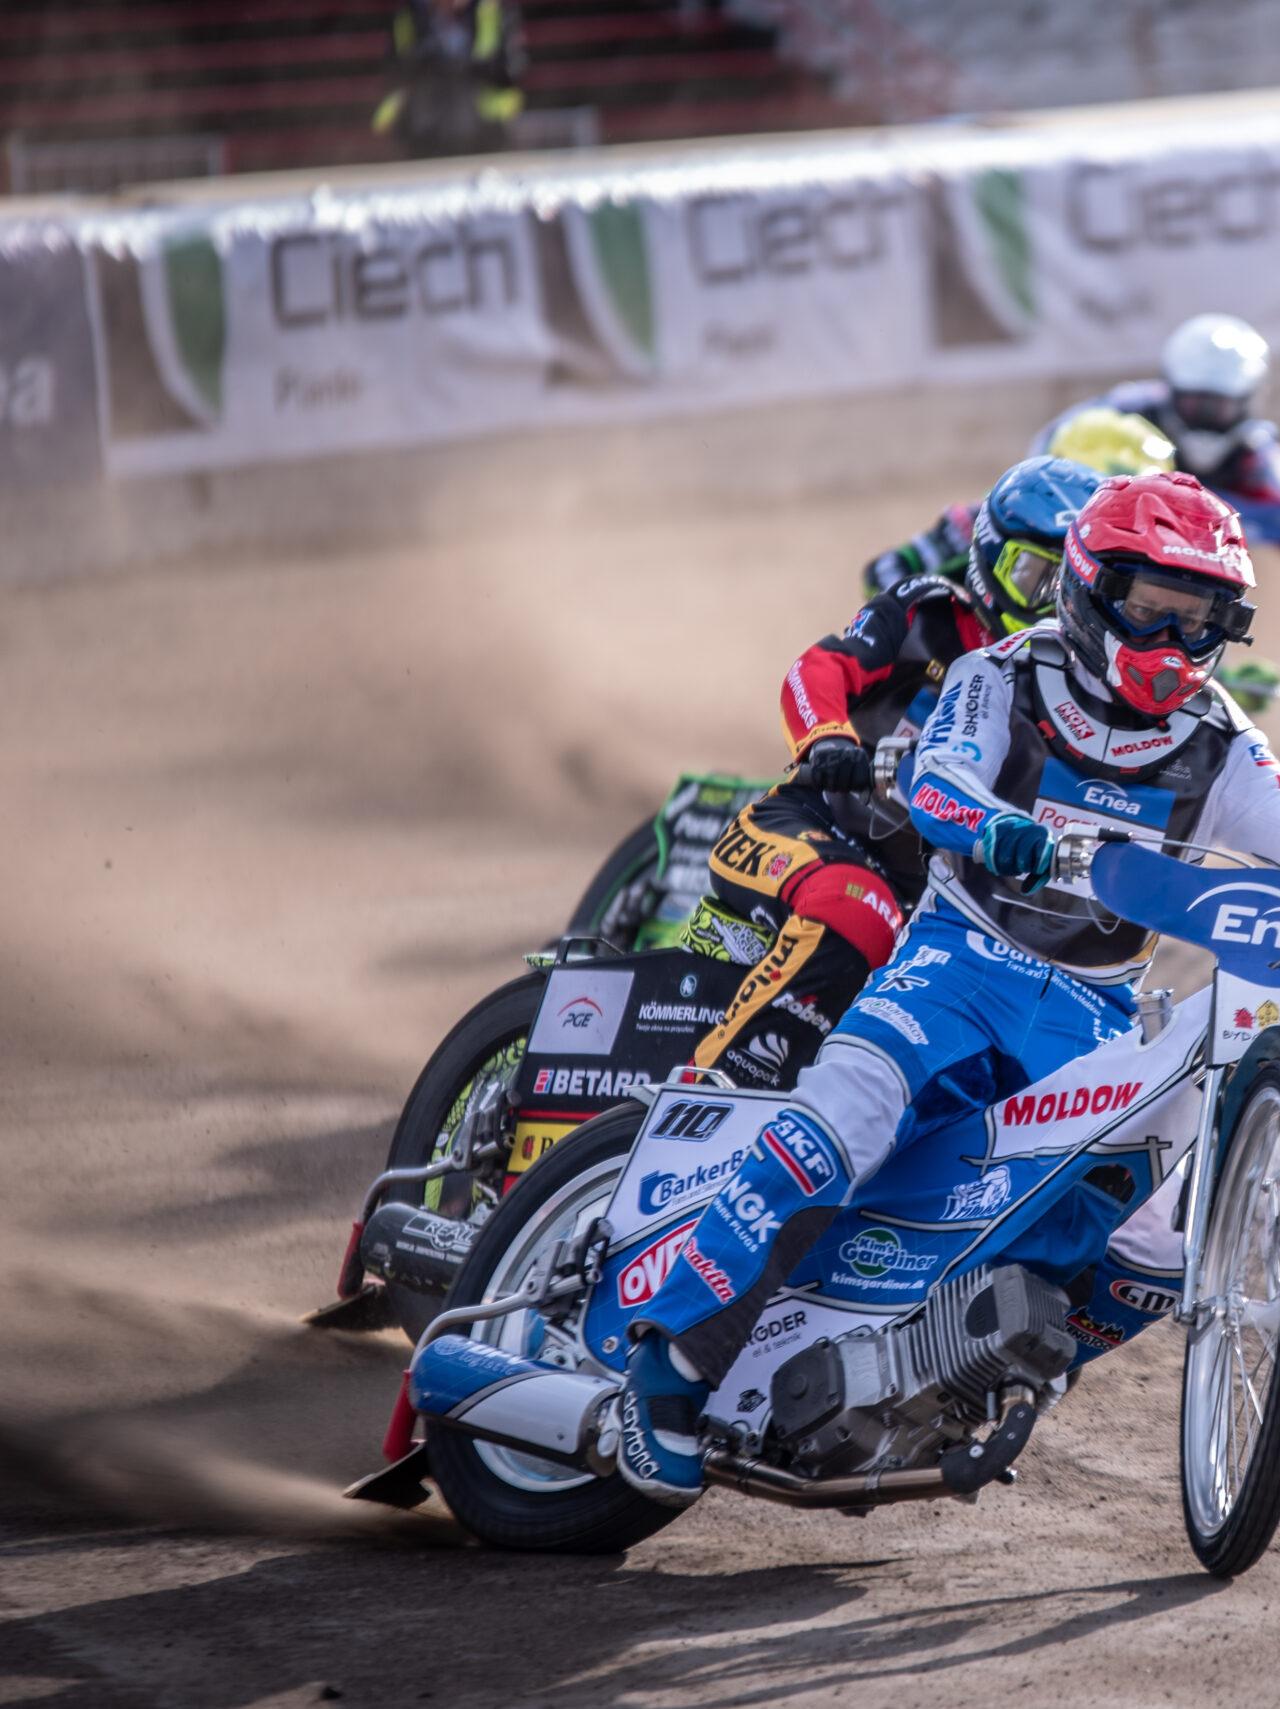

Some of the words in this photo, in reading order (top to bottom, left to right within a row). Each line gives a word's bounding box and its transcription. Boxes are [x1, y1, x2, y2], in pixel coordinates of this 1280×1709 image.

[271, 222, 518, 329] Ciech
[1110, 735, 1174, 758] MOLDOW
[912, 782, 987, 833] MOLDOW
[1083, 786, 1142, 816] Enea
[562, 1012, 593, 1028] PGE
[638, 1000, 726, 1025] KÖMMERLING
[651, 1101, 734, 1141] 110
[1004, 1081, 1143, 1127] MOLDOW
[774, 1119, 829, 1180] SKF
[659, 1146, 751, 1201] BarkerB
[720, 1173, 784, 1244] NGK
[840, 1241, 939, 1271] Gardiner
[859, 1236, 897, 1256] Kim's
[623, 1391, 661, 1480] daytona
